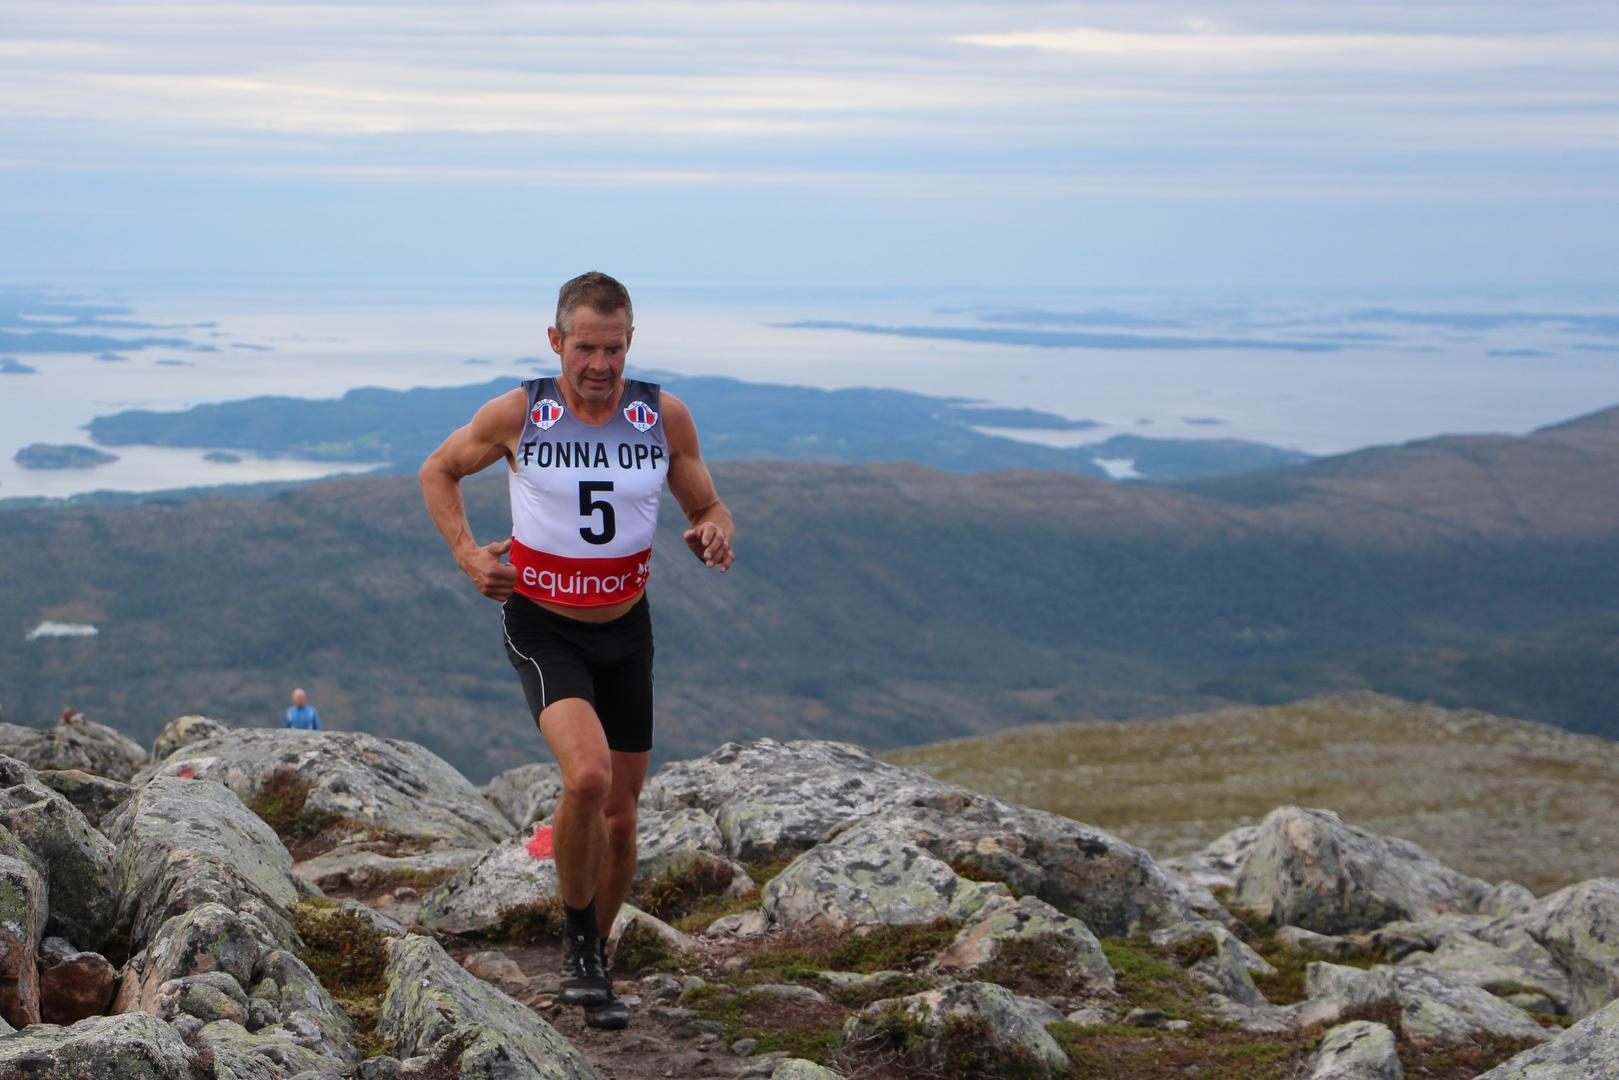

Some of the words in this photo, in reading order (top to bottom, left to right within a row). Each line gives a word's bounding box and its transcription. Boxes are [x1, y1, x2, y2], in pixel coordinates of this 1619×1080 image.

[524, 442, 609, 468] FONNA
[619, 442, 663, 469] OPP
[578, 481, 616, 545] 5
[523, 566, 631, 597] equinor
